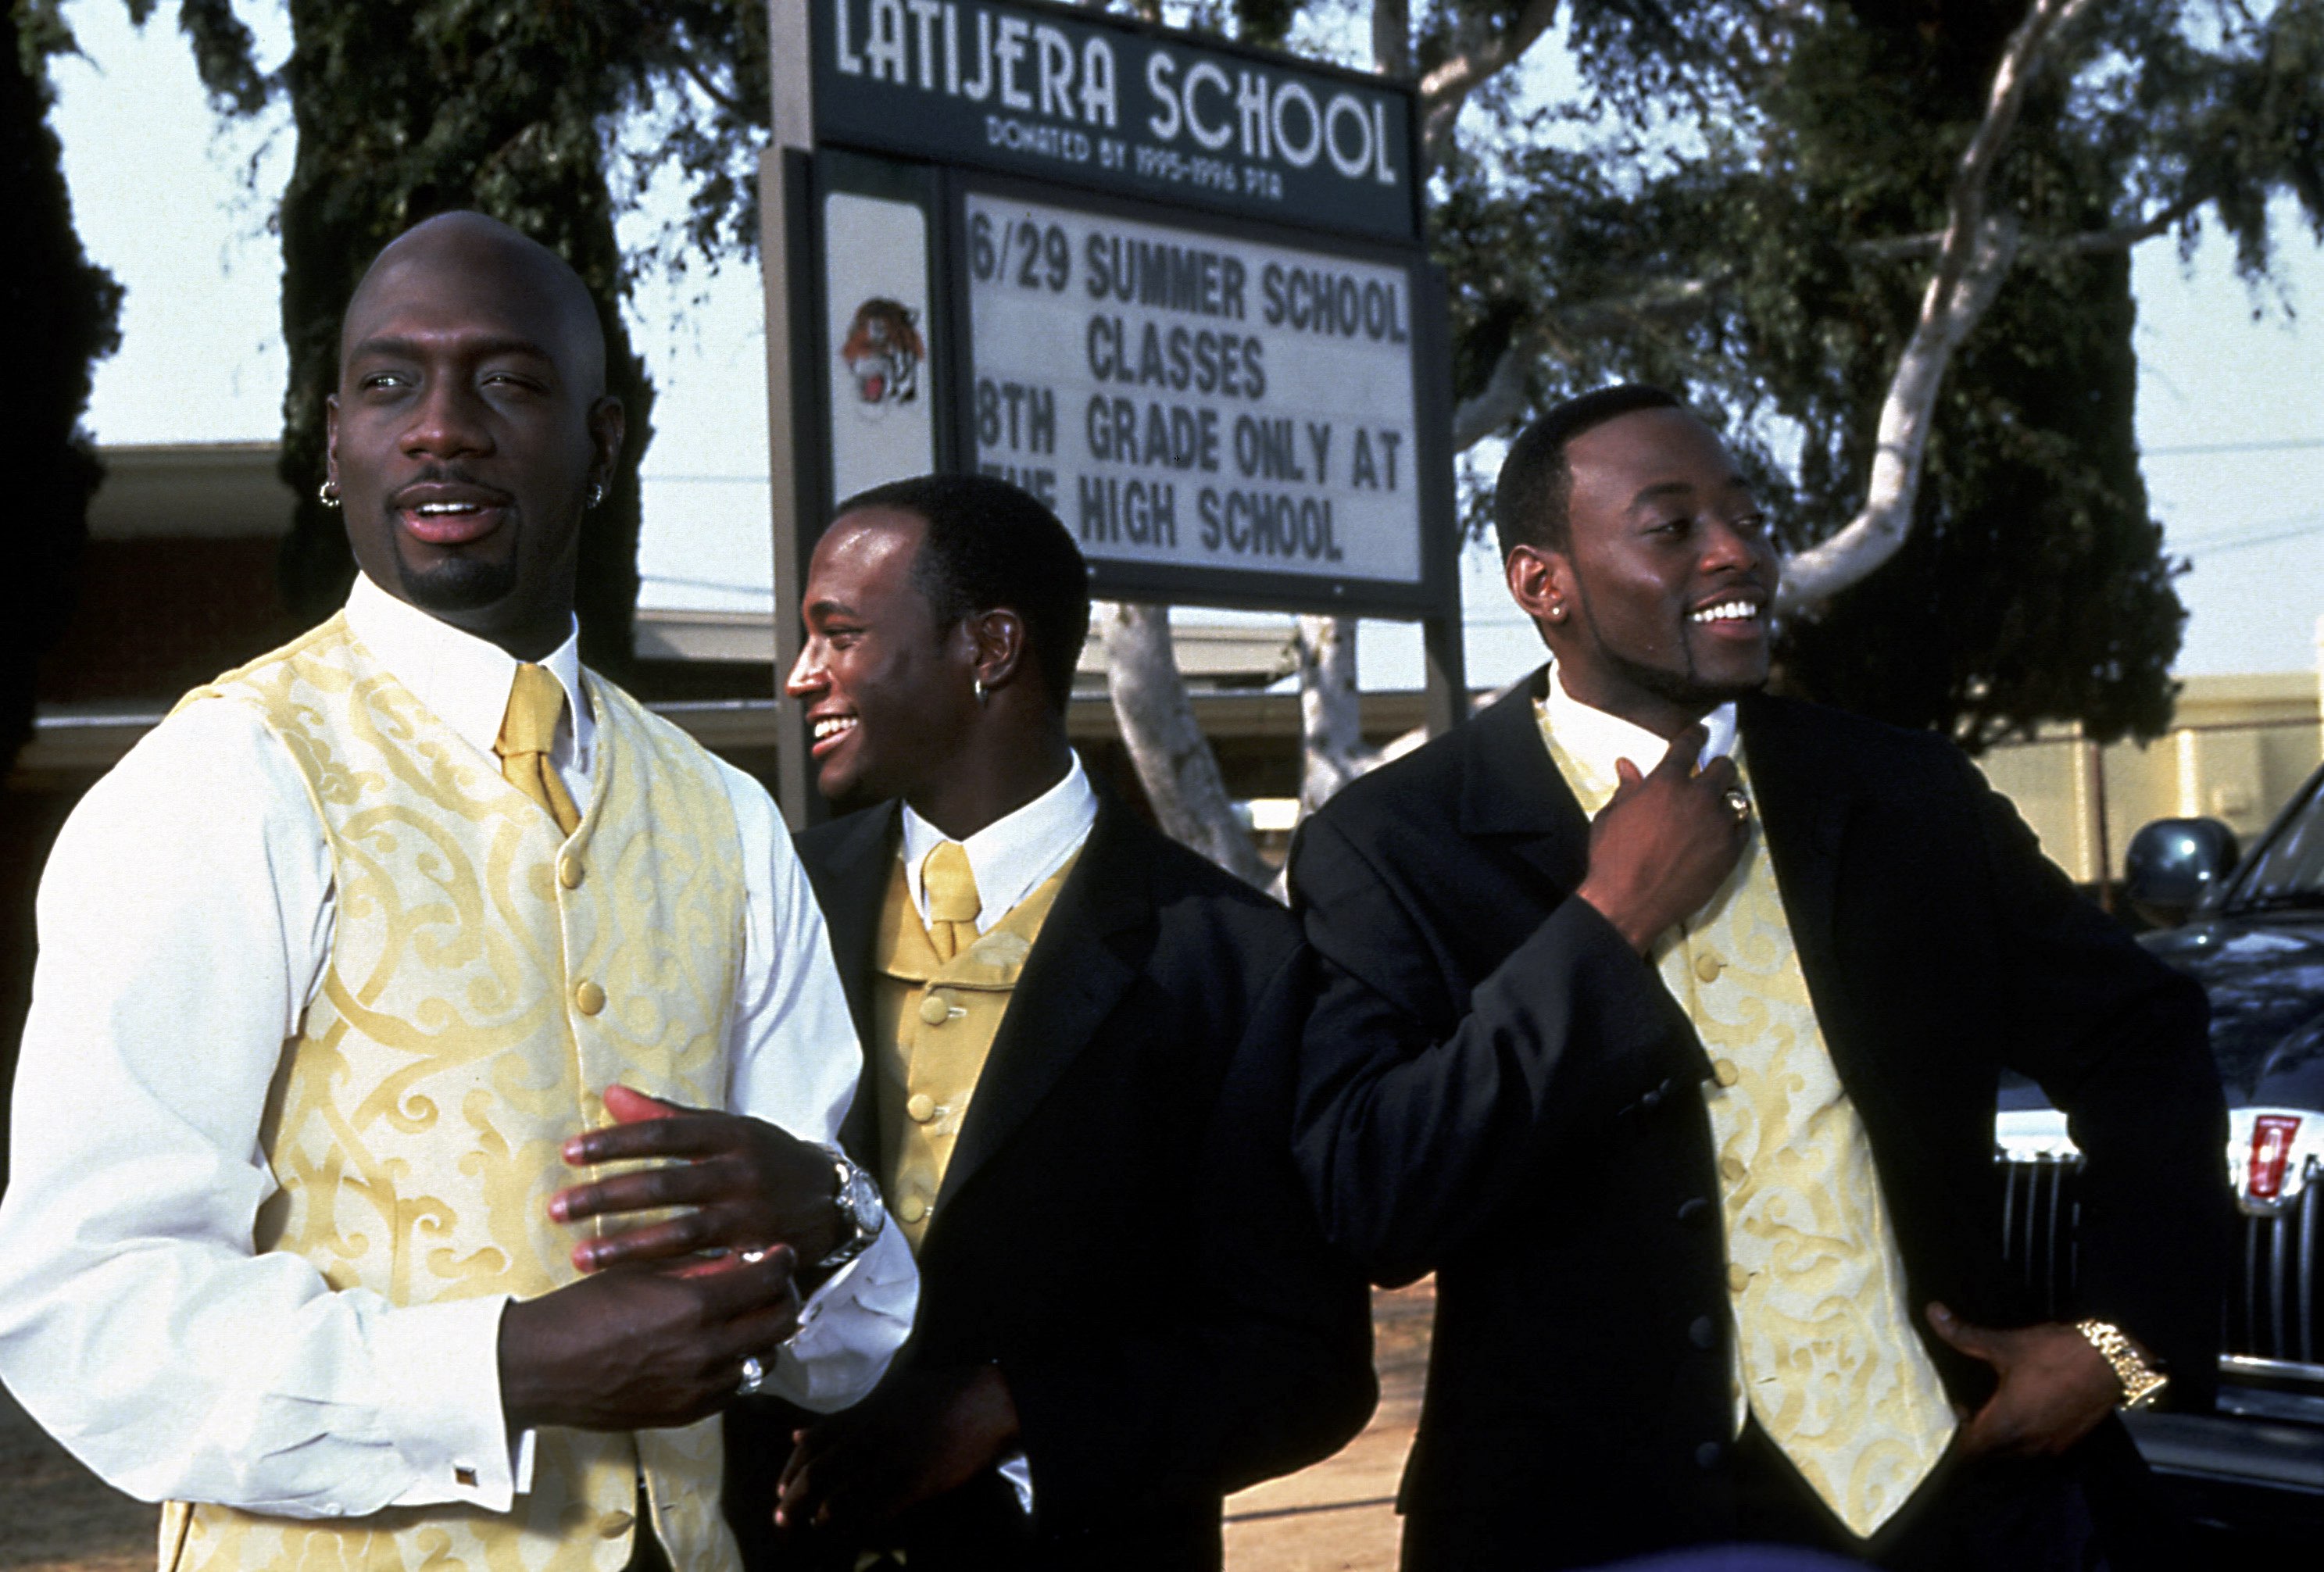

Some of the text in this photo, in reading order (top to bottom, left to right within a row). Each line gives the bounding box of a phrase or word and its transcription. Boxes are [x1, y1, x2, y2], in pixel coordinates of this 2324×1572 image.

[985, 114, 1283, 201] DONATED BY 1995-1996 PTA
[1146, 51, 1396, 184] SCHOOL
[970, 212, 1407, 344] 6/29 SUMMER SCHOOL
[1086, 315, 1266, 401] CLASSES
[976, 378, 1403, 491] 8TH GRADE ONLY AT
[1078, 474, 1176, 547] HIGH
[1199, 488, 1343, 563] SCHOOL
